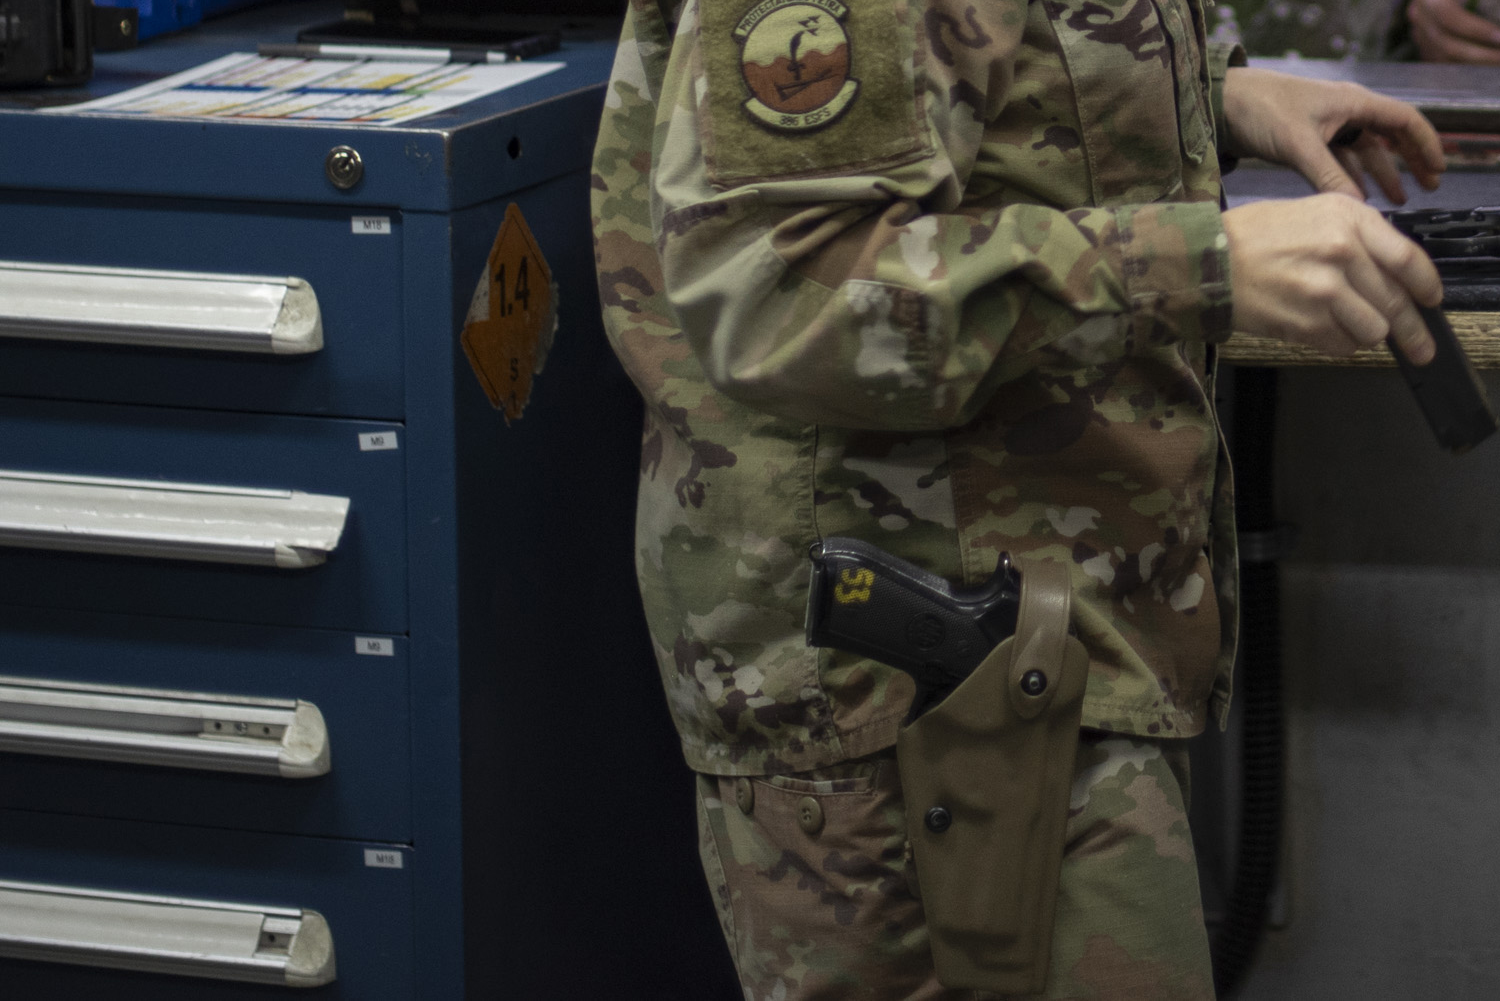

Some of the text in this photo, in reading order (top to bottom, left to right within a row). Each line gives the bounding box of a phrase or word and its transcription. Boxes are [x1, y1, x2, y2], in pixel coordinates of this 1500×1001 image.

[805, 107, 831, 125] ESFS
[363, 218, 382, 230] M18
[494, 255, 531, 318] 1.4
